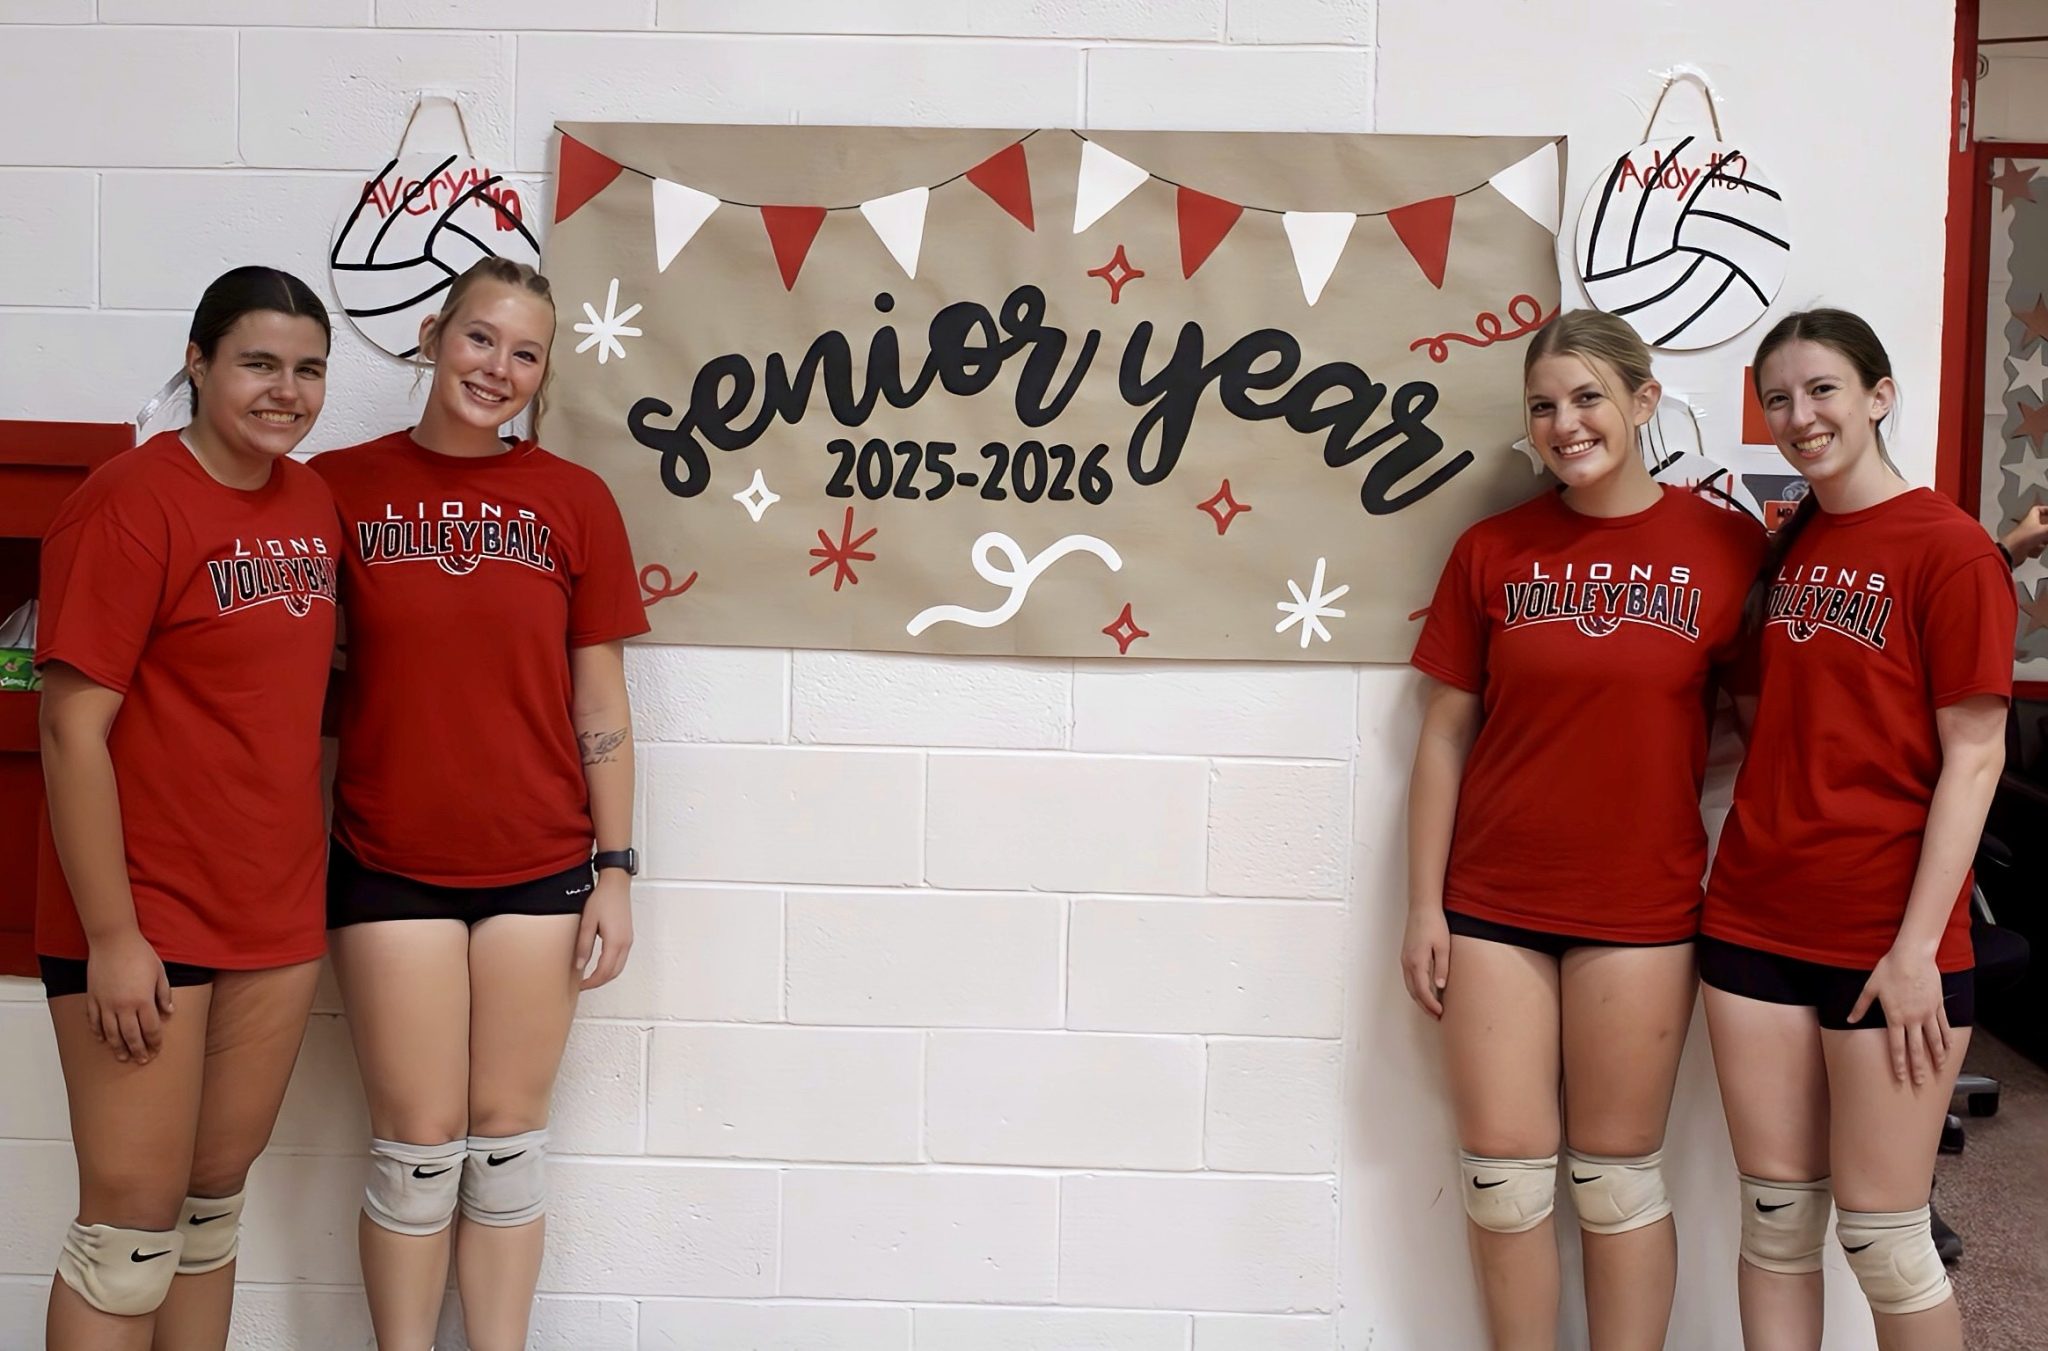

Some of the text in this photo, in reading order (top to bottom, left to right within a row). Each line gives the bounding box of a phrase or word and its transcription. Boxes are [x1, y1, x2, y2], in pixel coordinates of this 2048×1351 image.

[1618, 150, 1750, 202] Addy #2
[627, 285, 1475, 515] senior year
[825, 438, 1113, 505] 2025-2026
[235, 537, 327, 556] LIONS
[357, 519, 555, 573] VOLLEYBALL
[1533, 561, 1691, 585] LIONS
[1778, 564, 1885, 593] LIONS
[1504, 581, 1702, 640] VOLLEYBALL
[1767, 583, 1893, 650] OLLEYBALL
